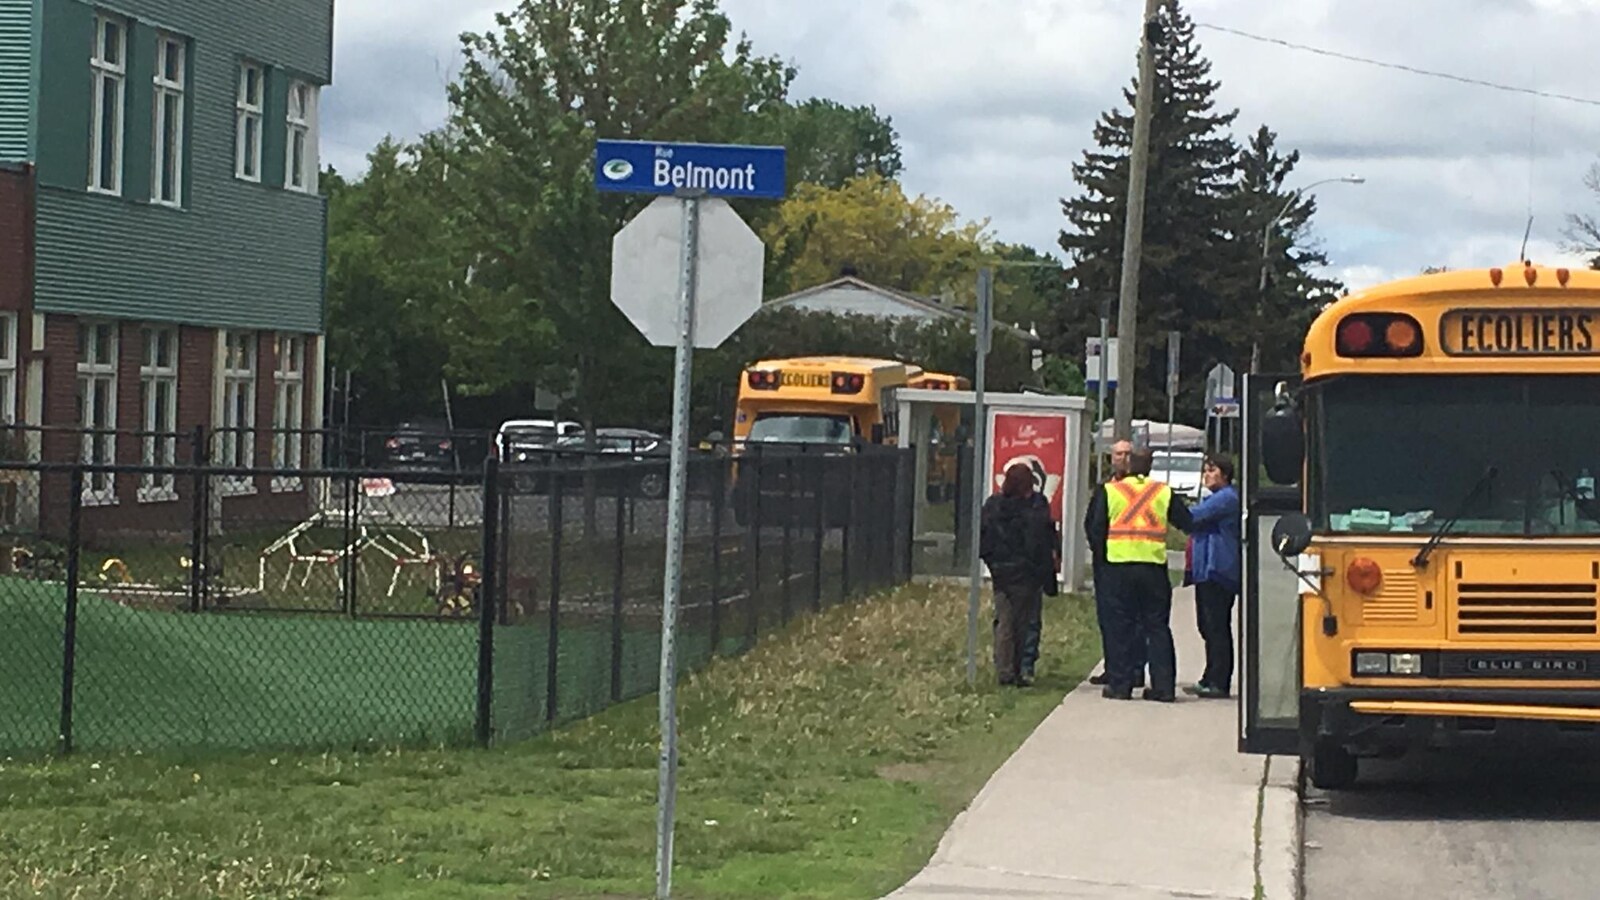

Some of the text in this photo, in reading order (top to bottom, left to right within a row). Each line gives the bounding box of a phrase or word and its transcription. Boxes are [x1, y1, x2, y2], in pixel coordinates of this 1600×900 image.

[655, 146, 674, 159] Rue
[654, 159, 756, 191] Belmont
[1461, 313, 1593, 352] ECOLIERS
[780, 372, 831, 387] ECOLIERS
[1477, 660, 1577, 670] BLUE BIRD
